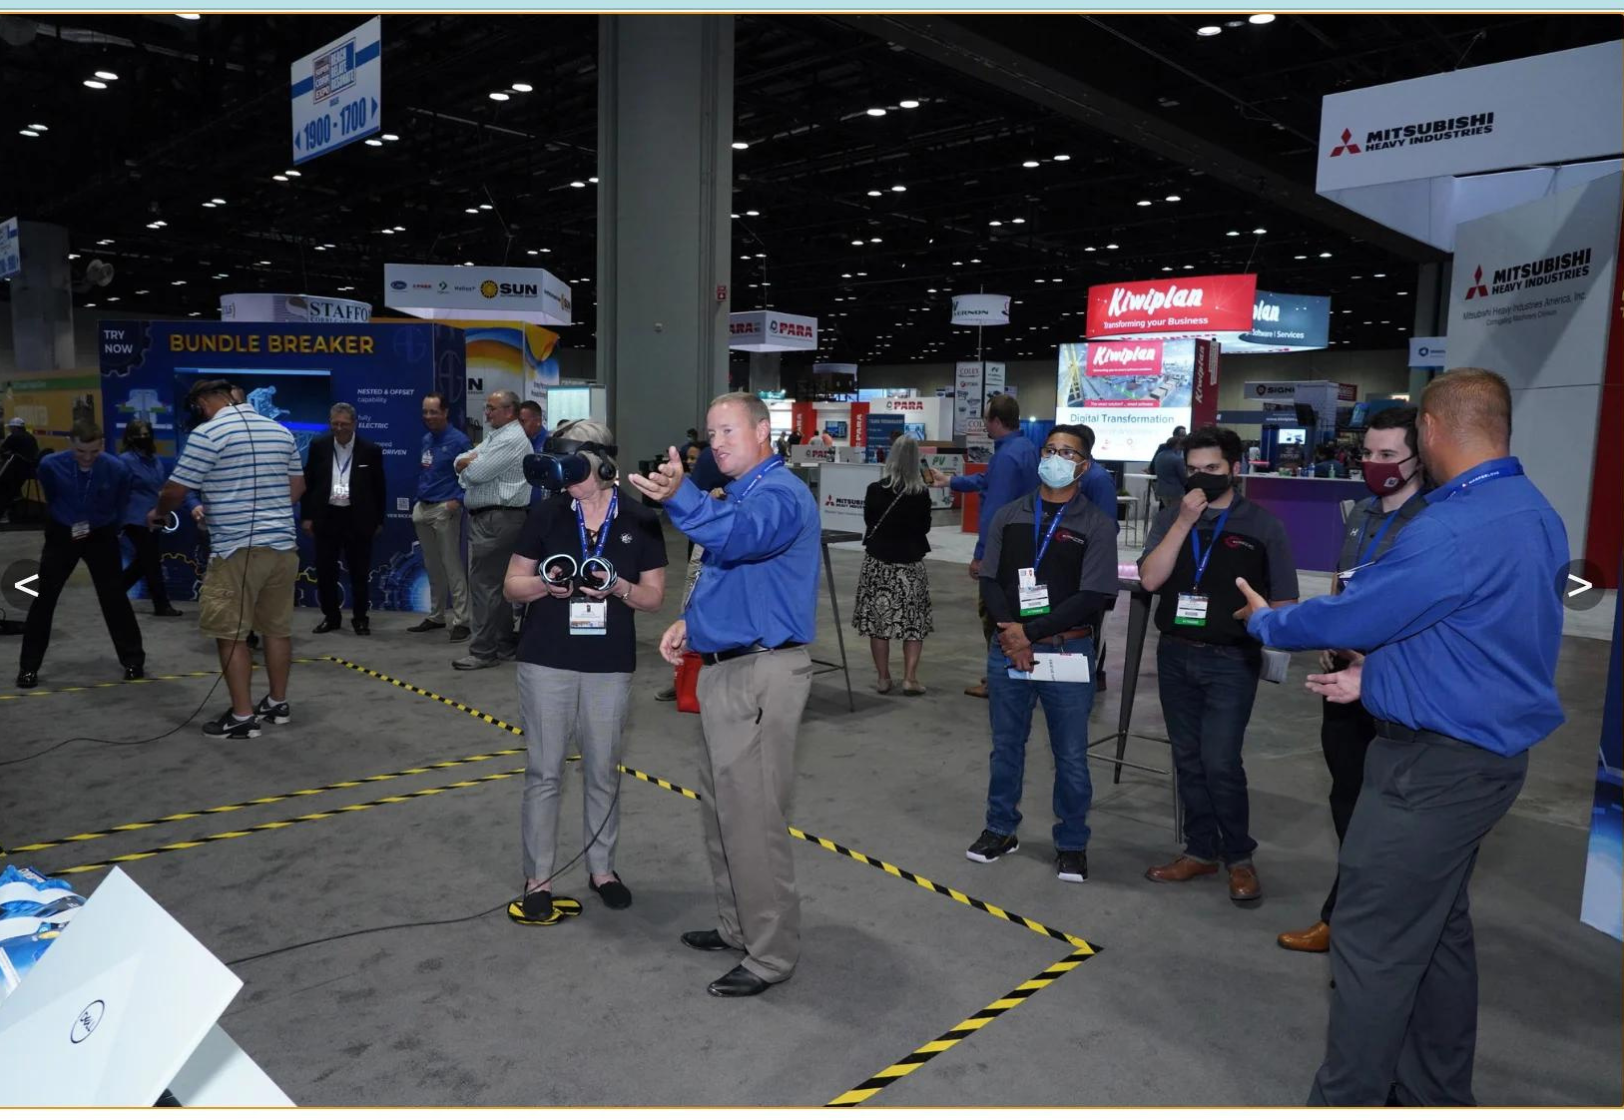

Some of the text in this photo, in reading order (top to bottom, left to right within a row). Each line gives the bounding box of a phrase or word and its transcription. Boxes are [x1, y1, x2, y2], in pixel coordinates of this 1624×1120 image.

[304, 113, 331, 151] 1900
[340, 97, 366, 136] 1700
[1366, 111, 1495, 144] MITSUBISHI
[1365, 124, 1493, 152] HEAVY INDUSTRIES
[1492, 247, 1592, 285] MITSUBISHI
[1491, 265, 1590, 296] HEAVY INDUSTRIES
[500, 283, 538, 296] SUN
[1107, 284, 1204, 318] Kiwiplan
[780, 322, 813, 338] PARA
[1103, 317, 1209, 330] Transforming your Business
[103, 330, 125, 340] TRY
[1276, 330, 1305, 339] Services
[104, 344, 133, 354] NOW
[169, 334, 375, 354] BUNDLE BREAKER
[1092, 346, 1157, 366] Kiwiplan
[1194, 345, 1206, 404] Kiwiplan
[357, 388, 383, 396] NESTED
[389, 388, 416, 396] OFFSET
[893, 401, 924, 410] PARA
[358, 422, 389, 430] ELECTRIC
[1070, 413, 1175, 425] Digital Transformation
[381, 448, 408, 456] DRIVEN
